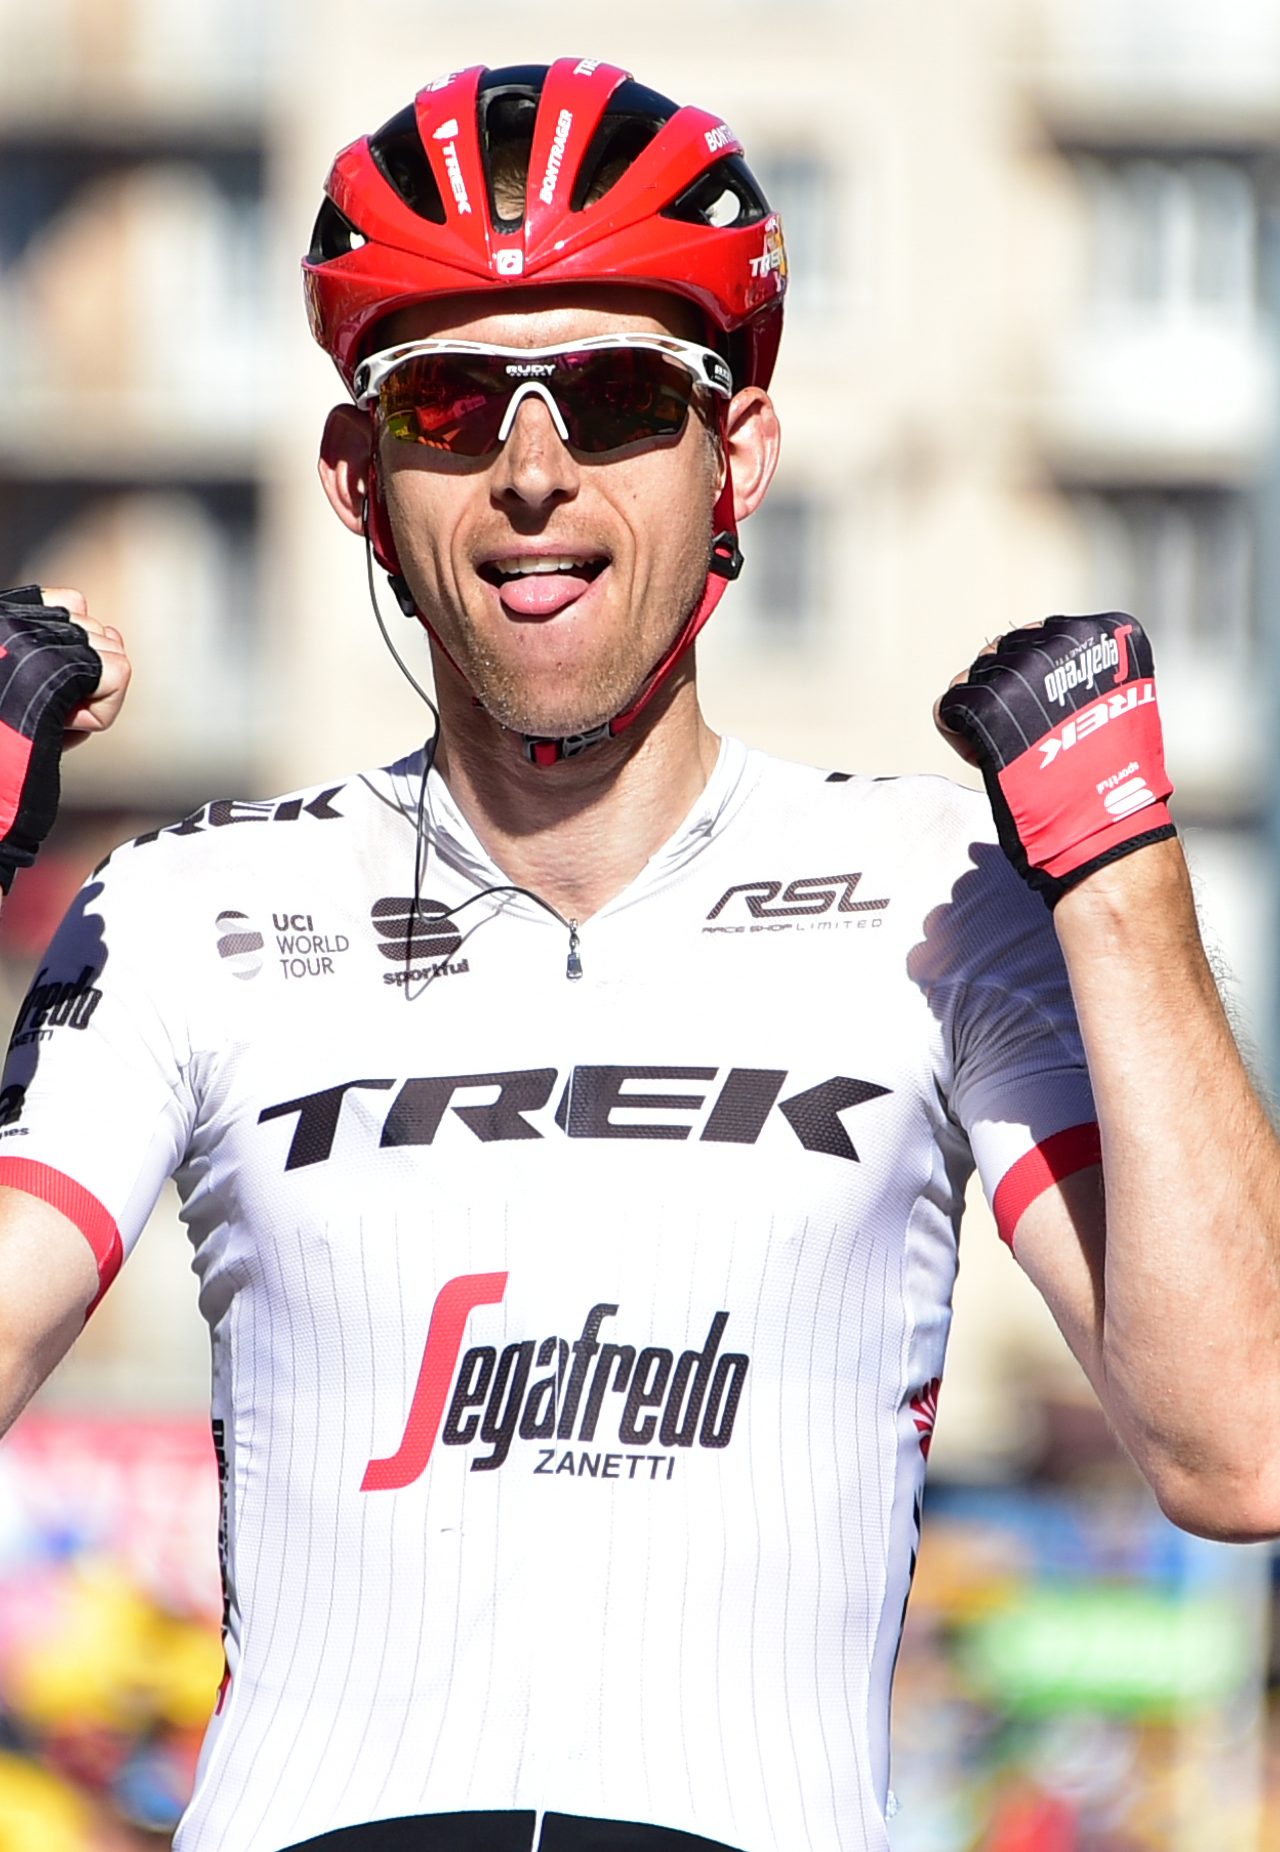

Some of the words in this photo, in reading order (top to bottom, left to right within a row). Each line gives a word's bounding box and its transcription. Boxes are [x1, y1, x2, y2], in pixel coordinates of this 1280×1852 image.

[540, 108, 573, 205] BONTRAGER
[442, 140, 472, 216] TREK
[749, 249, 784, 278] TRE
[506, 364, 556, 377] RUDY
[1044, 623, 1133, 708] Segafredo
[1038, 682, 1156, 771] TREK
[1095, 760, 1140, 795] sportful
[92, 783, 348, 881] REK
[706, 872, 891, 920] RSL
[271, 912, 315, 932] UCI
[796, 917, 883, 932] LIMITED
[276, 934, 350, 955] WORLD
[280, 956, 336, 980] TOUR
[382, 958, 471, 988] sportful
[257, 1064, 895, 1172] TREK
[359, 1270, 750, 1493] Segafredo
[533, 1448, 675, 1482] ZANETTI
